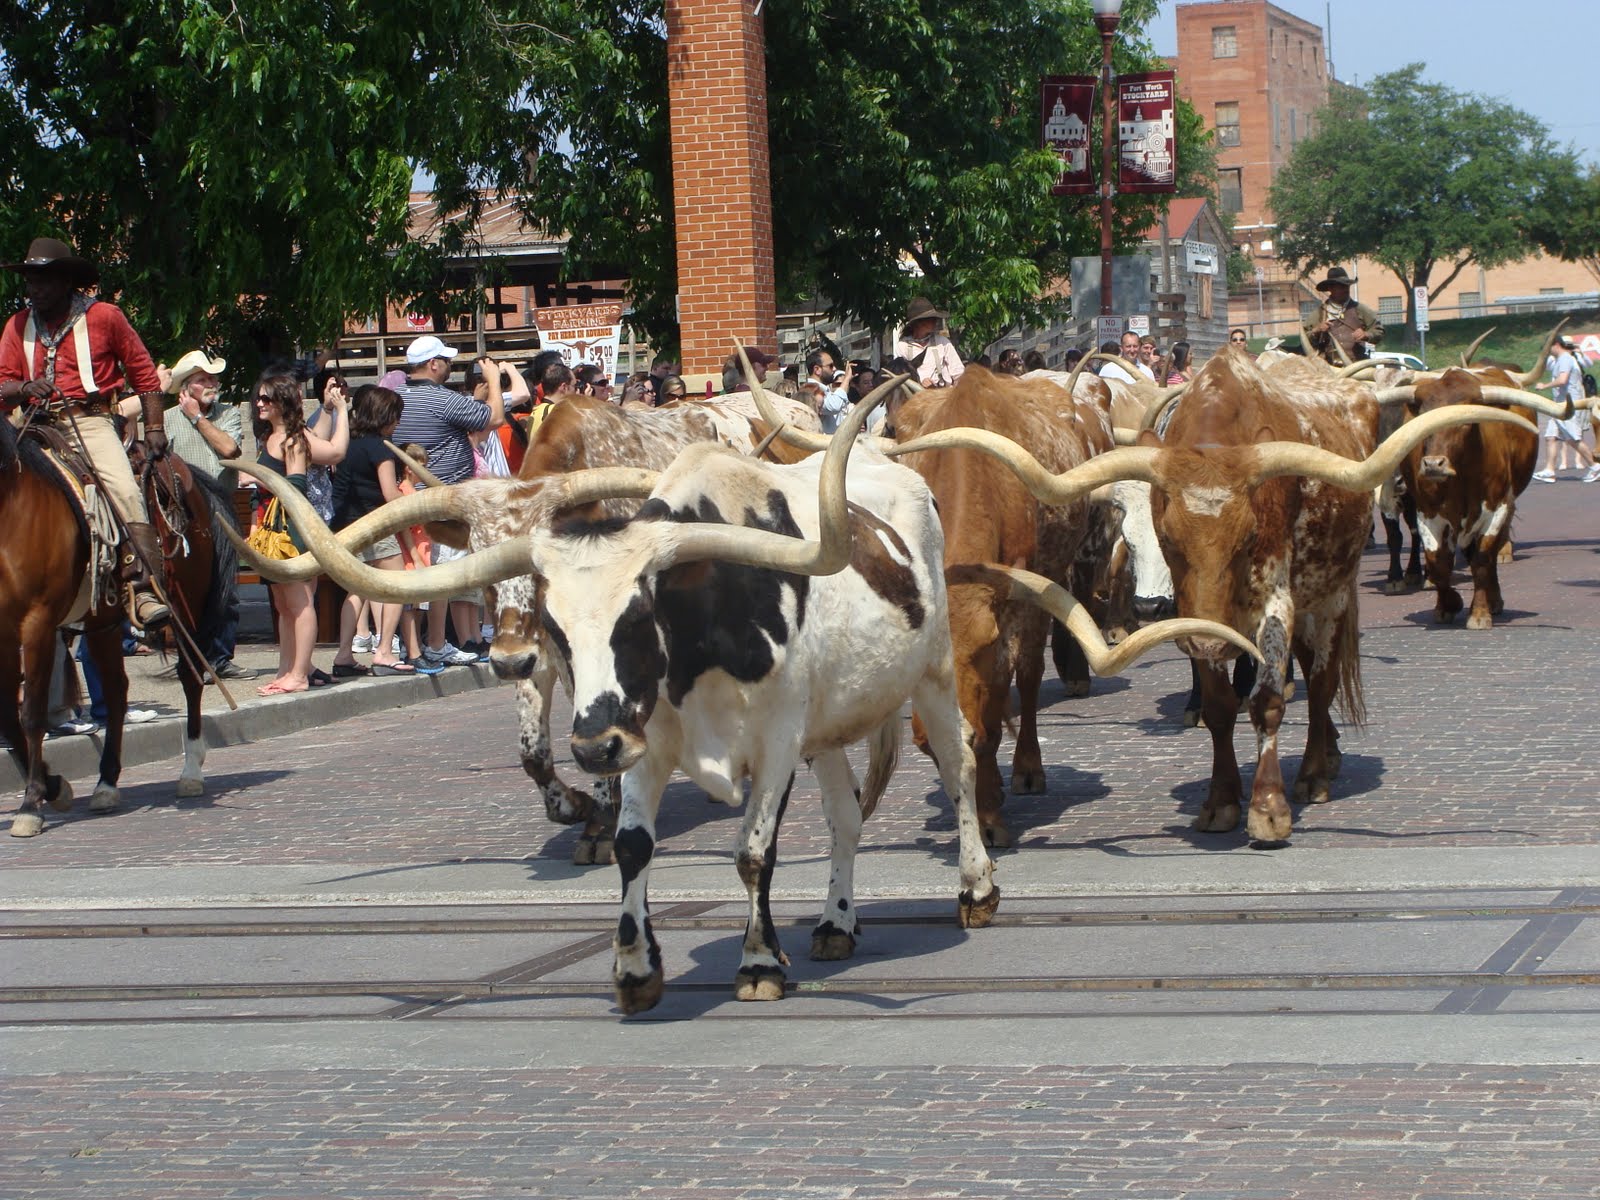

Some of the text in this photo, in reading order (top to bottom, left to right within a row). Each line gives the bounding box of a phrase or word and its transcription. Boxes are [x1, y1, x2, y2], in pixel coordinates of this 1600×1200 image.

[1145, 83, 1163, 91] Worth
[1122, 90, 1169, 100] STOCKYARDS
[538, 305, 621, 321] STOCKYARDS
[553, 316, 607, 330] PARKING
[1105, 319, 1116, 327] NO
[548, 328, 613, 340] PAY HERE IN ADVANCE
